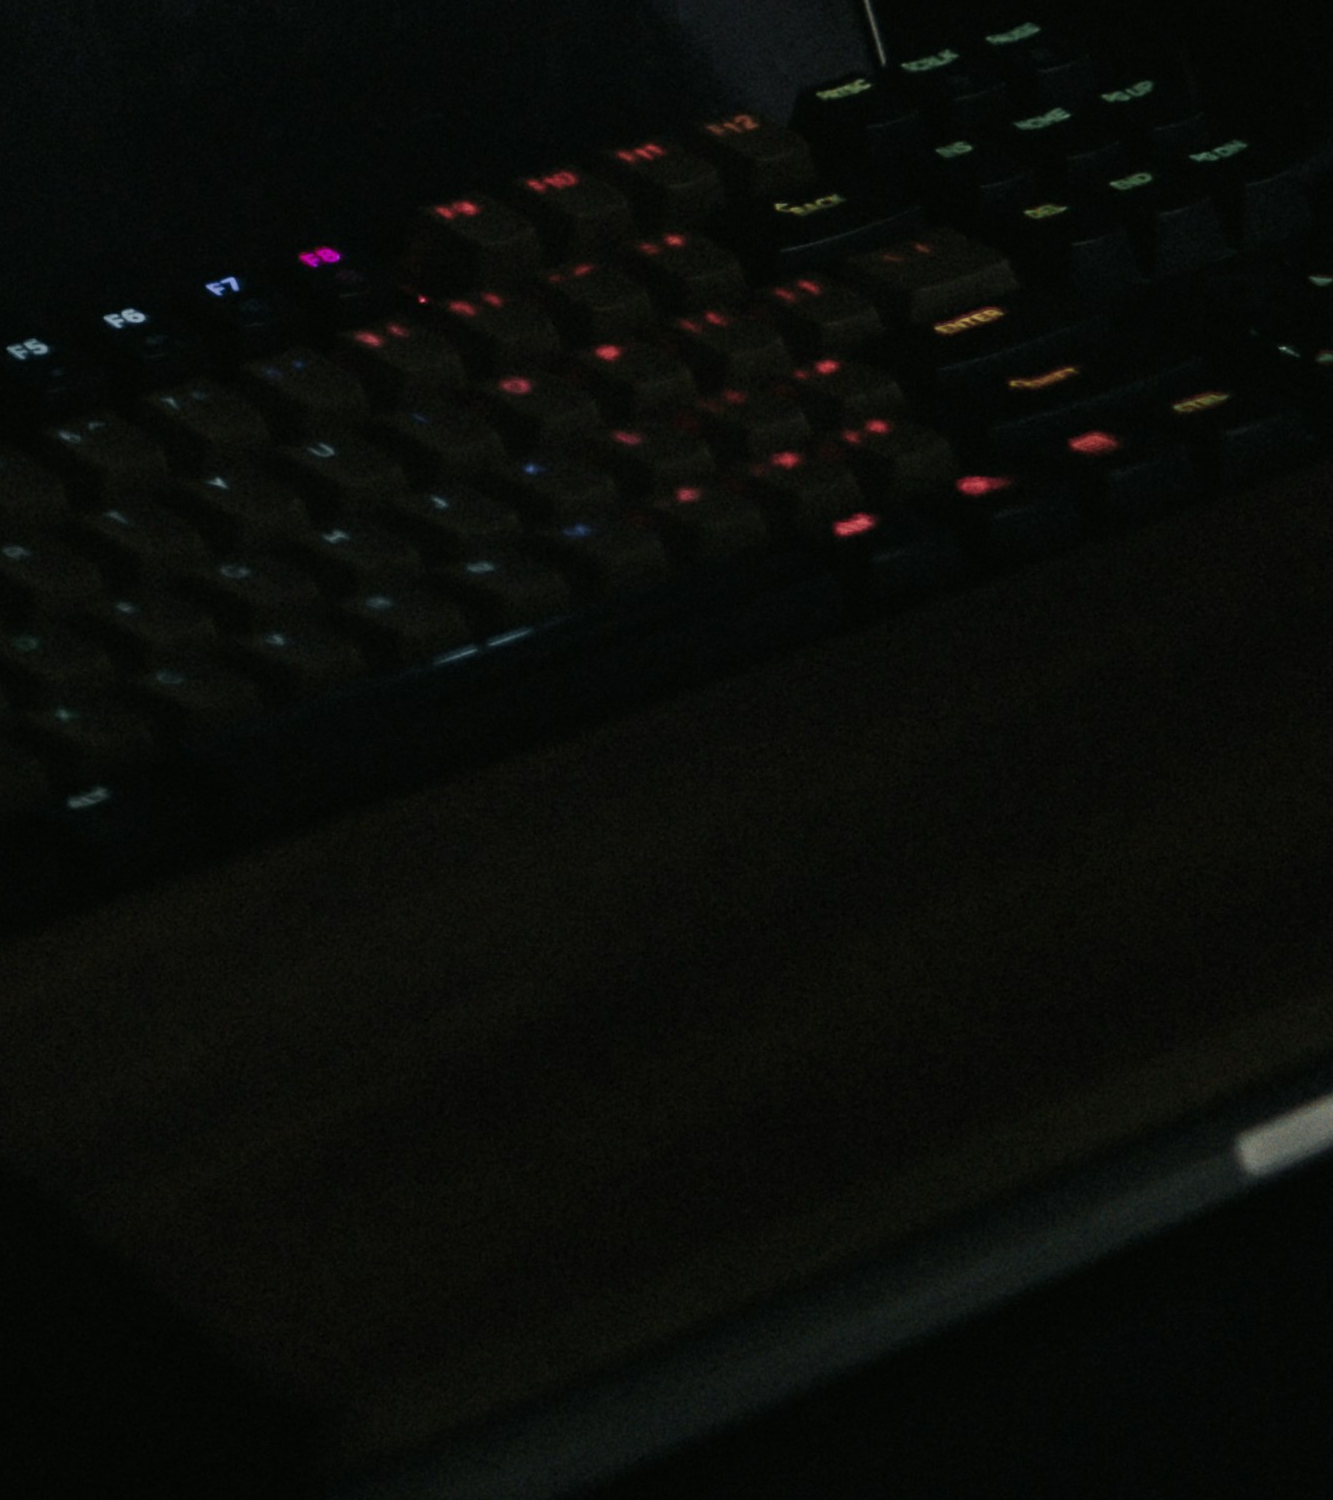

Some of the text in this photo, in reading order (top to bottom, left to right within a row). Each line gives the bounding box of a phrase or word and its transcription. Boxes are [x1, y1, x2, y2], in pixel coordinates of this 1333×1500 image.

[206, 276, 241, 297] F7
[103, 308, 145, 330] F6
[7, 338, 50, 360] F5
